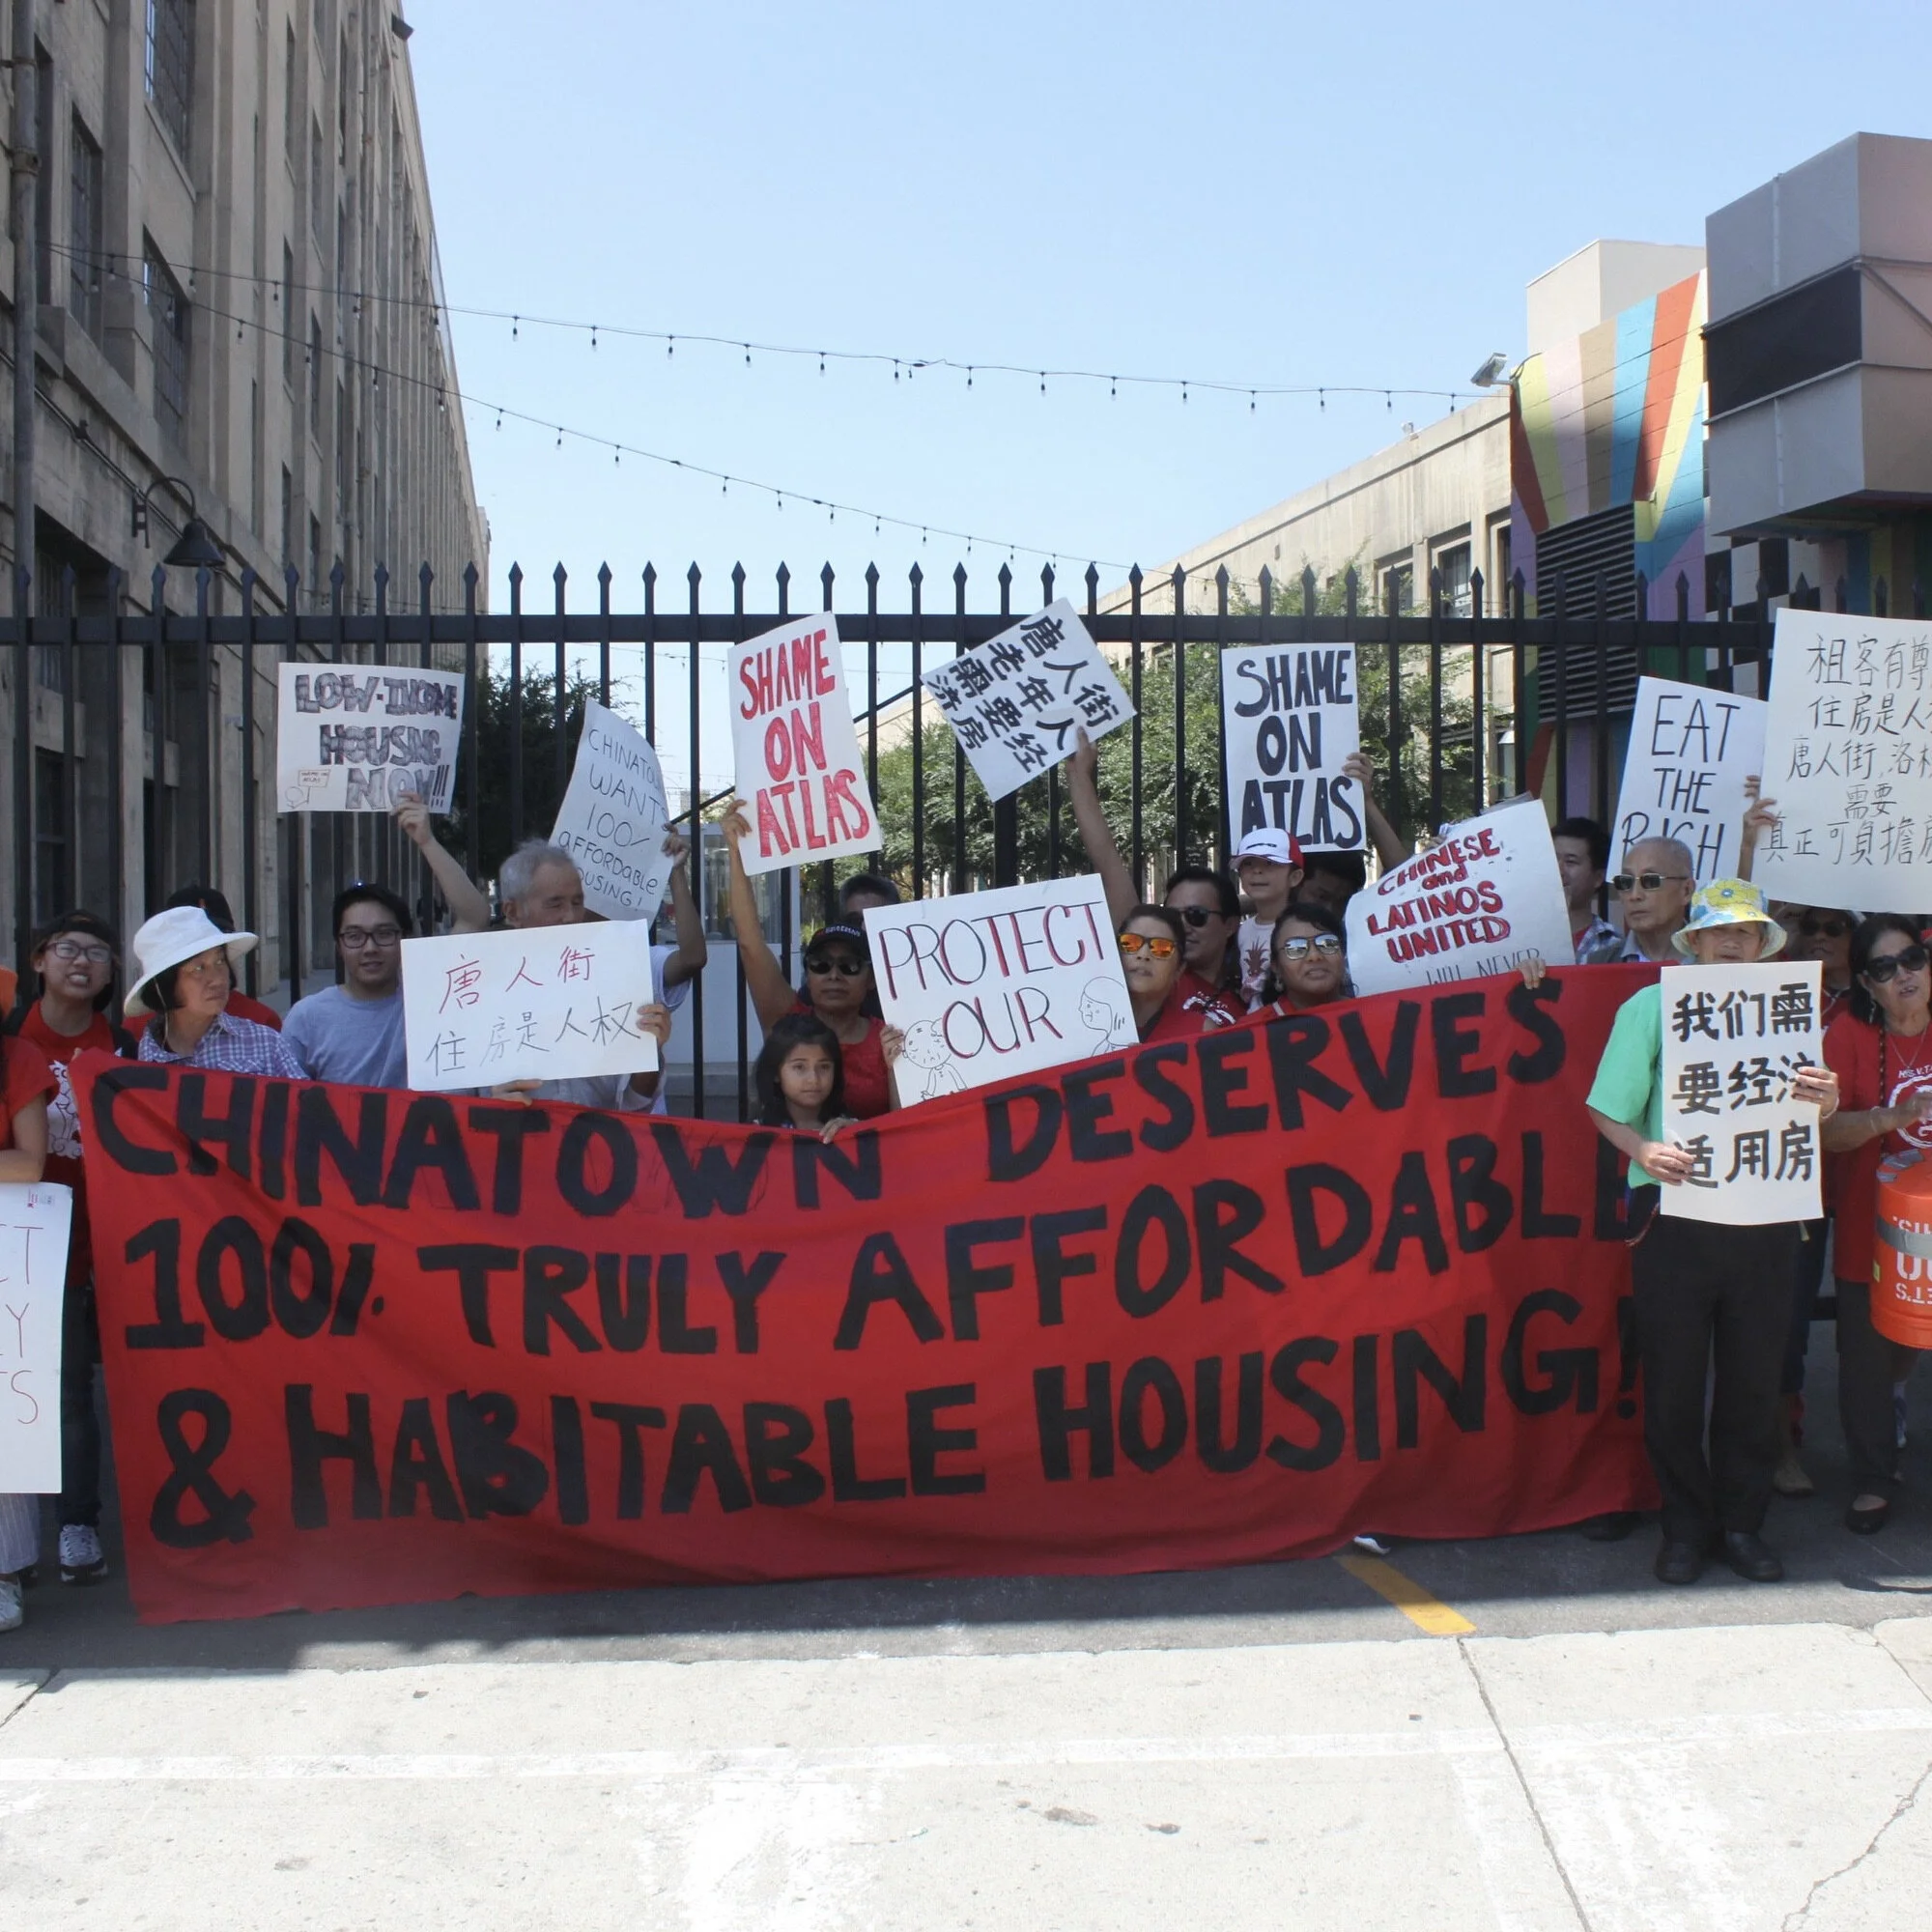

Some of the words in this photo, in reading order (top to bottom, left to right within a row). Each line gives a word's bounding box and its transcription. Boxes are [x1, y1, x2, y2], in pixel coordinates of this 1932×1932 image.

[740, 629, 836, 720] SHAME
[1020, 615, 1120, 727] 唐人街
[1234, 650, 1353, 718] SHAME
[1806, 633, 1932, 691] 租客有尊
[987, 642, 1074, 751] 老年人
[1652, 695, 1741, 762] EAT
[1807, 692, 1932, 735] 住房是人
[320, 724, 441, 766] HOUSING
[588, 729, 662, 790] CHINATO
[764, 701, 828, 781] ON
[1257, 712, 1321, 776] ON
[756, 769, 870, 858] ATLAS
[1241, 776, 1362, 849] ATLAS
[1654, 768, 1717, 813] THE
[1844, 782, 1897, 819] 需要
[1378, 828, 1500, 895] CHINESE
[1422, 862, 1469, 890] and
[1367, 880, 1503, 936] LATINOS
[1386, 915, 1511, 963] UNITED
[439, 946, 595, 1014] 唐人街
[878, 900, 1103, 1001] PROTECT
[425, 996, 641, 1077] 住房是人权
[942, 987, 1064, 1059] OUR
[1672, 982, 1813, 1042] 我们需
[92, 1065, 882, 1219] CHINATOWN
[983, 979, 1567, 1182] DESERVES
[417, 1244, 787, 1355] TRULY
[149, 1387, 258, 1548] &
[283, 1383, 986, 1530] HABITABLE
[1032, 1291, 1640, 1482] HOUSING!
